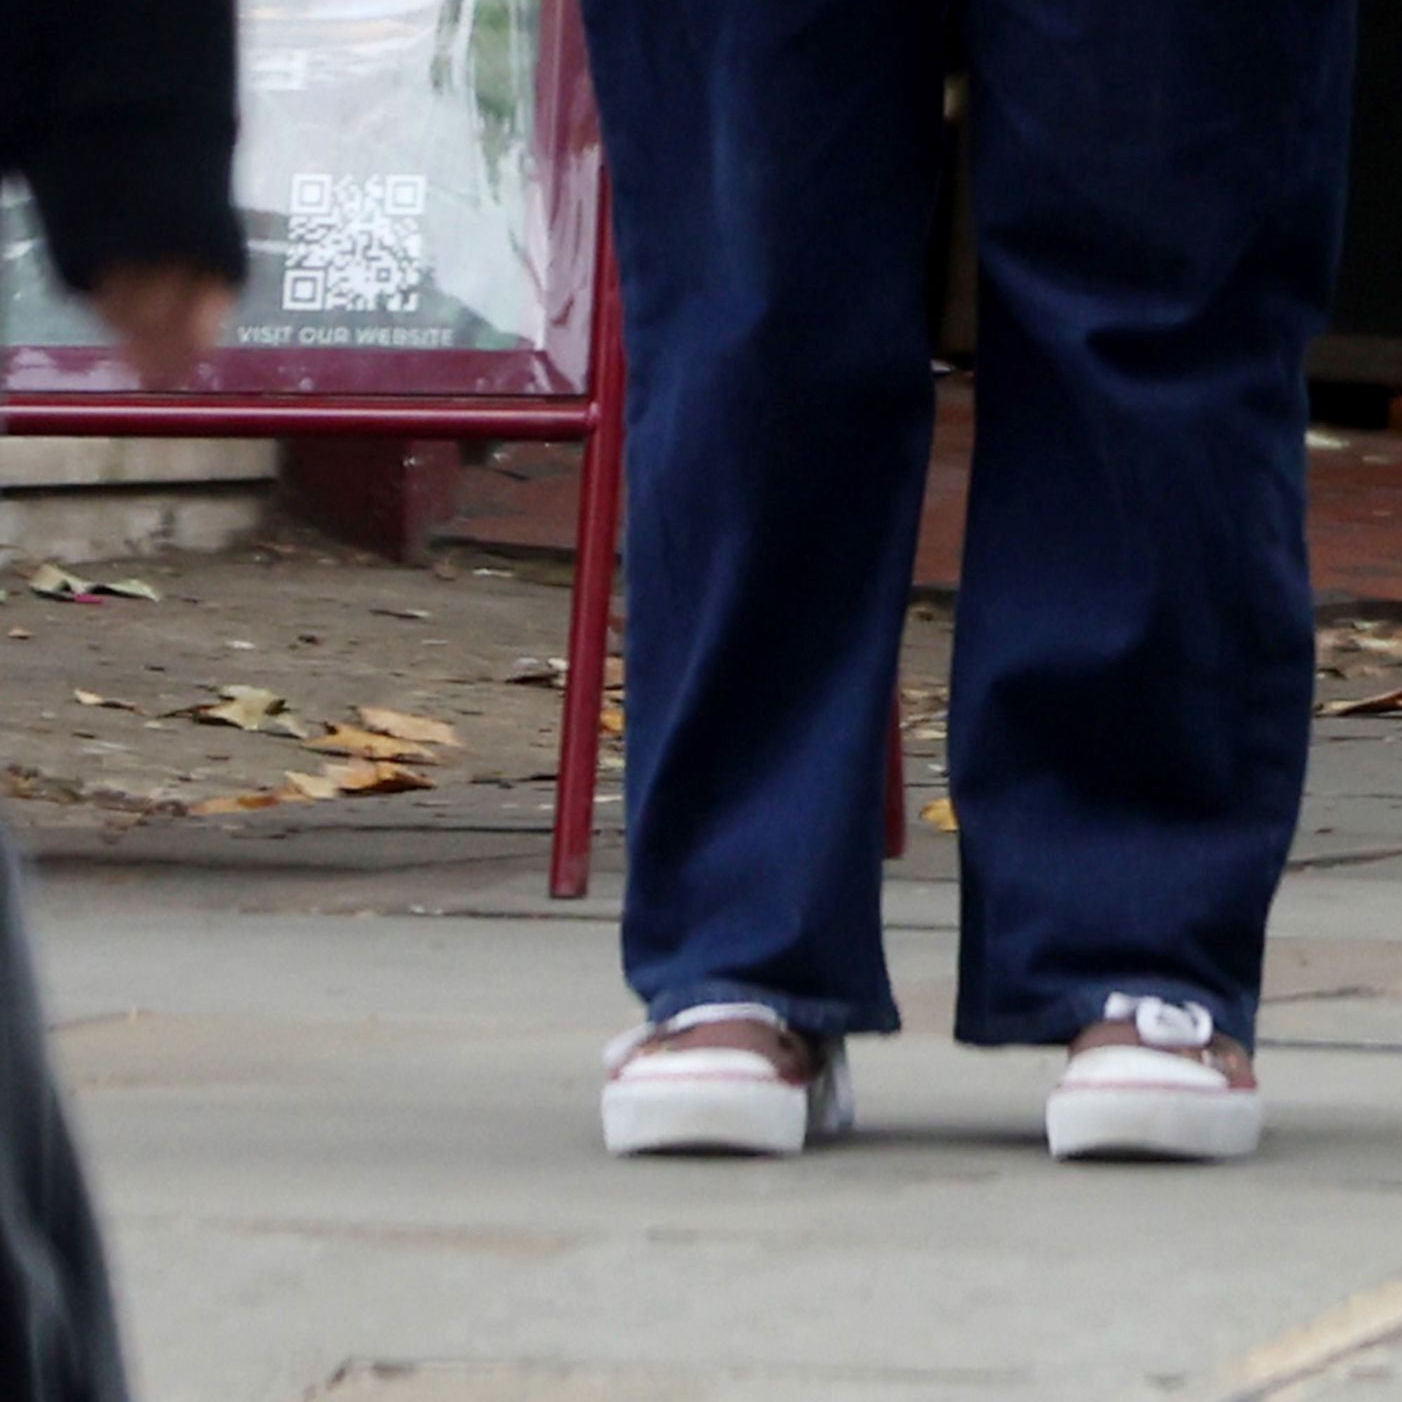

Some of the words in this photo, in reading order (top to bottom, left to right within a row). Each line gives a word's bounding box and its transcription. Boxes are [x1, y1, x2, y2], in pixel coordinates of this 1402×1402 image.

[237, 325, 294, 345] VISIT
[298, 326, 349, 344] OUR
[356, 326, 454, 346] WEBSITE
